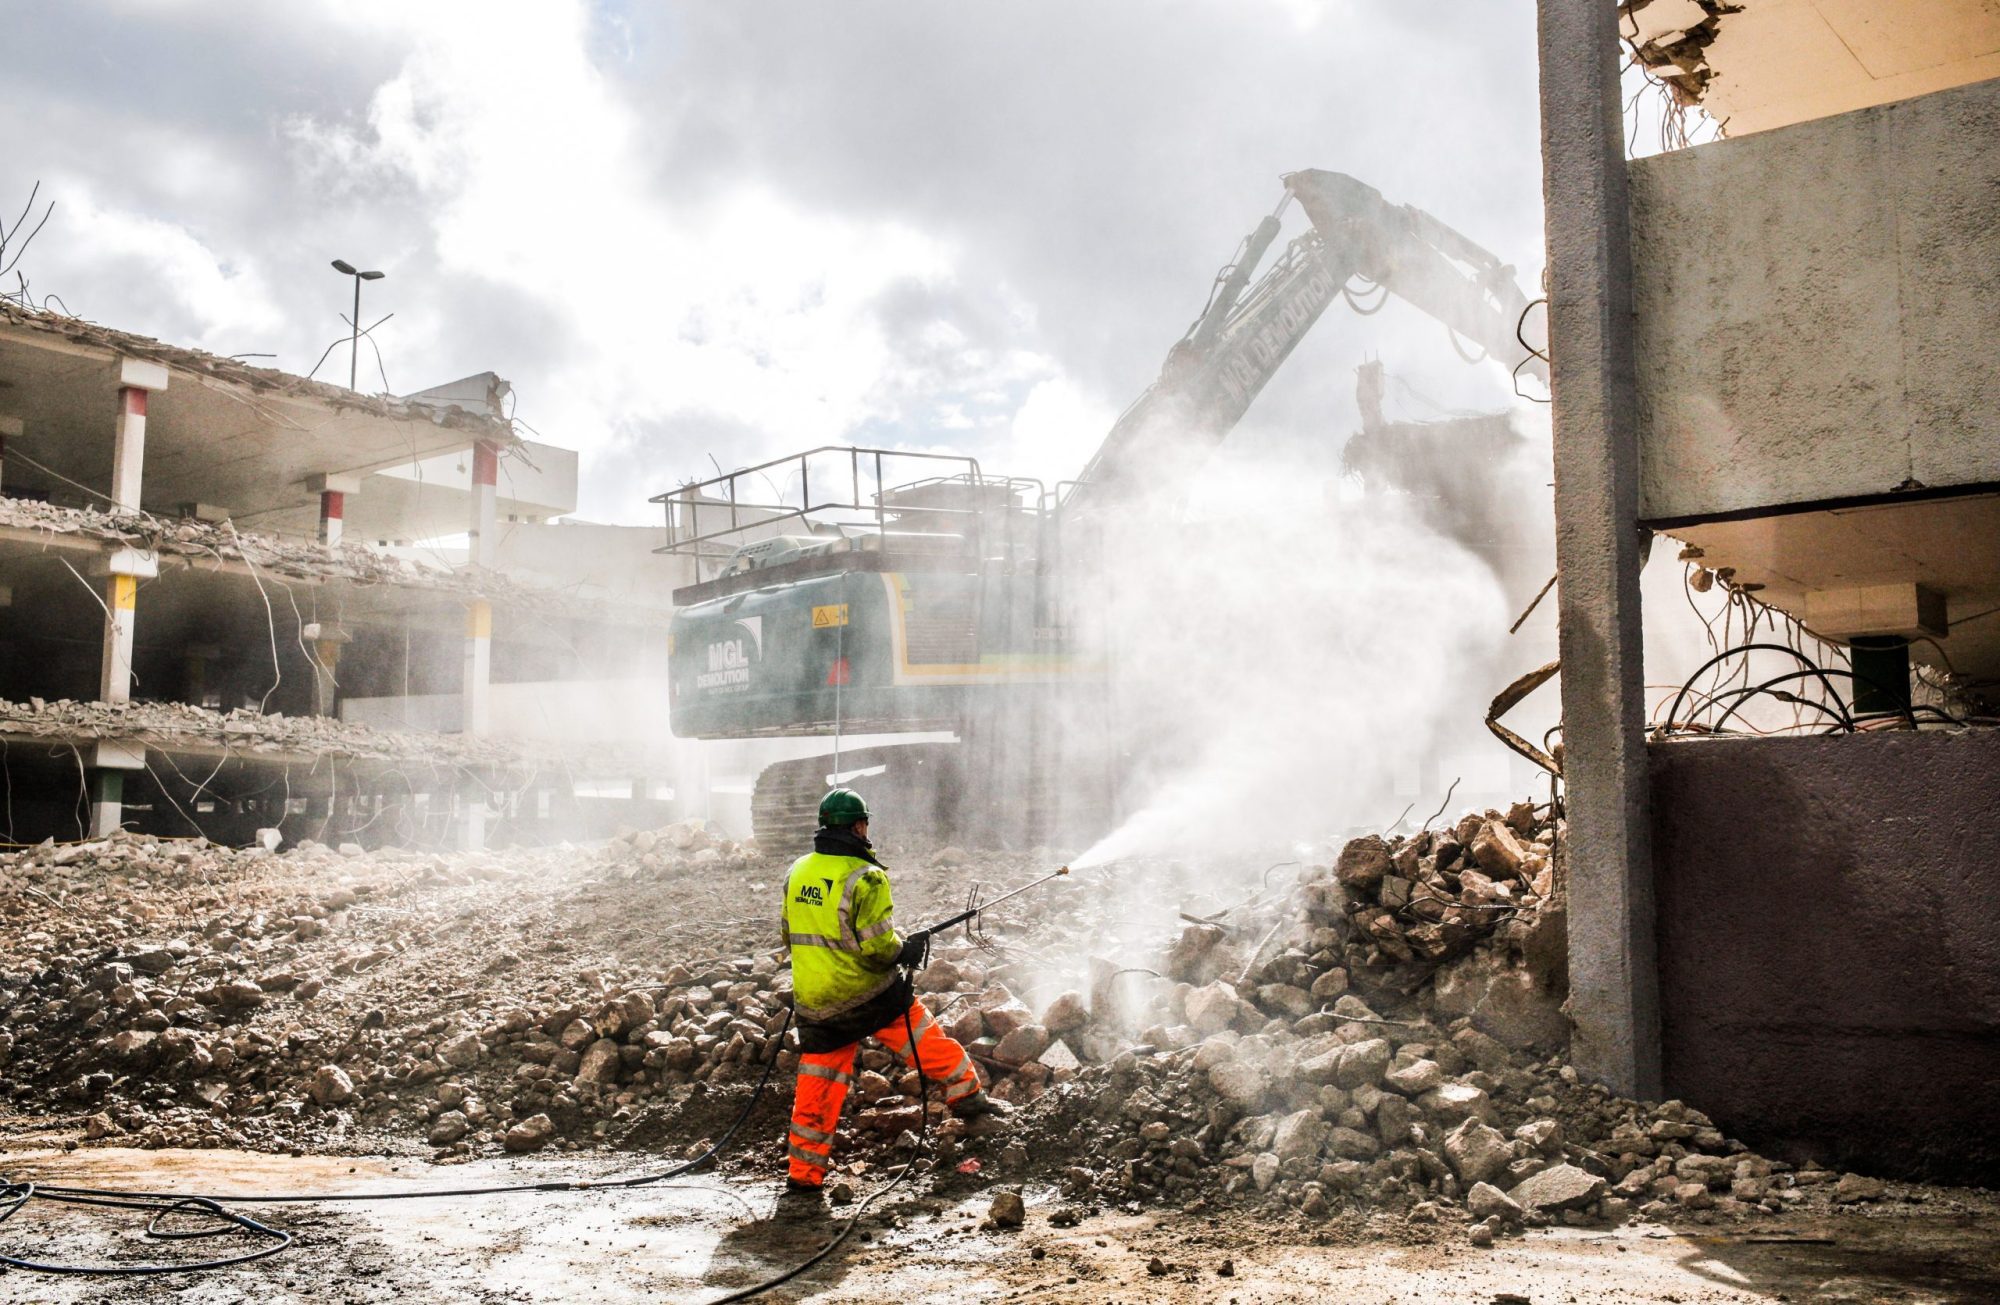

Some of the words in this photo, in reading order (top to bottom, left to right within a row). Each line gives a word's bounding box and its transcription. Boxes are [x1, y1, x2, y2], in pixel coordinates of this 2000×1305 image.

[1218, 353, 1262, 399] MGL
[1249, 266, 1335, 366] DEMOLITION
[708, 639, 749, 672] MGL
[697, 668, 750, 689] DEMOLITION
[801, 885, 823, 900] MGL
